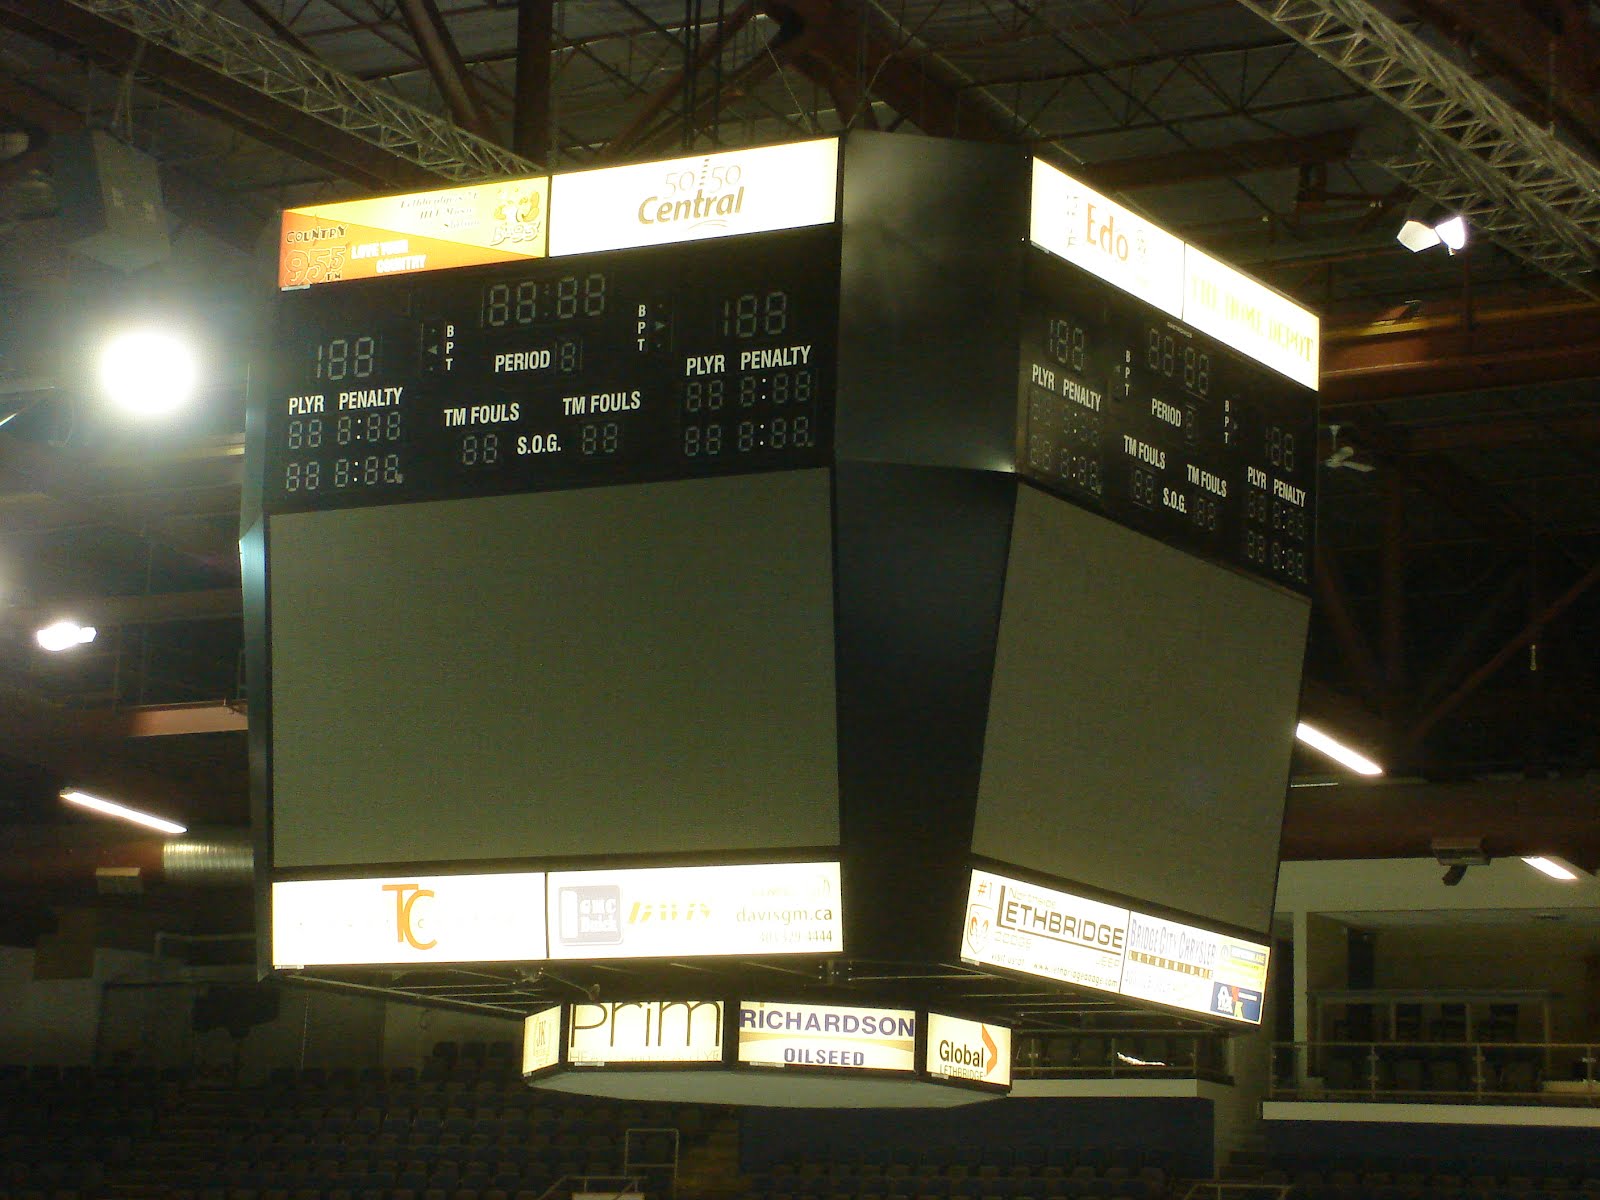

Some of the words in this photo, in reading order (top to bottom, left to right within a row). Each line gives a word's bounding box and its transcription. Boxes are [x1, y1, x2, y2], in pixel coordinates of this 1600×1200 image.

[638, 187, 745, 225] Central
[286, 224, 349, 244] COUNTRY
[1086, 202, 1129, 262] Edo
[495, 350, 551, 373] PERIOD
[685, 354, 726, 377] PLYR
[740, 345, 811, 371] PENALTY
[288, 395, 324, 415] PLYR
[338, 387, 403, 410] PENALTY
[1032, 363, 1056, 392] PLYR
[1063, 378, 1102, 412] PENALTY
[444, 408, 467, 427] TM
[470, 402, 520, 425] FOULS
[562, 396, 586, 416] TM
[590, 391, 641, 413] FOULS
[1151, 397, 1182, 428] PERIOD
[516, 433, 562, 455] S.O.G.
[1123, 435, 1137, 455] TM
[1138, 438, 1166, 470] FOULS
[1187, 463, 1200, 483] TM
[1200, 467, 1227, 498] FOULS
[1247, 466, 1267, 490] PLYR
[1273, 478, 1306, 508] PENALTY
[1162, 487, 1188, 514] S.O.G.
[977, 880, 993, 899] #1
[736, 906, 832, 926] davisgm.ca
[996, 885, 1125, 949] LETHBRIDGE
[1130, 919, 1158, 953] BRIDGE
[1160, 926, 1177, 953] CITY
[1178, 932, 1216, 966] CHRYSLER
[740, 1009, 915, 1037] RICHARDSON
[784, 1047, 865, 1066] OILSEED
[939, 1039, 985, 1068] Global
